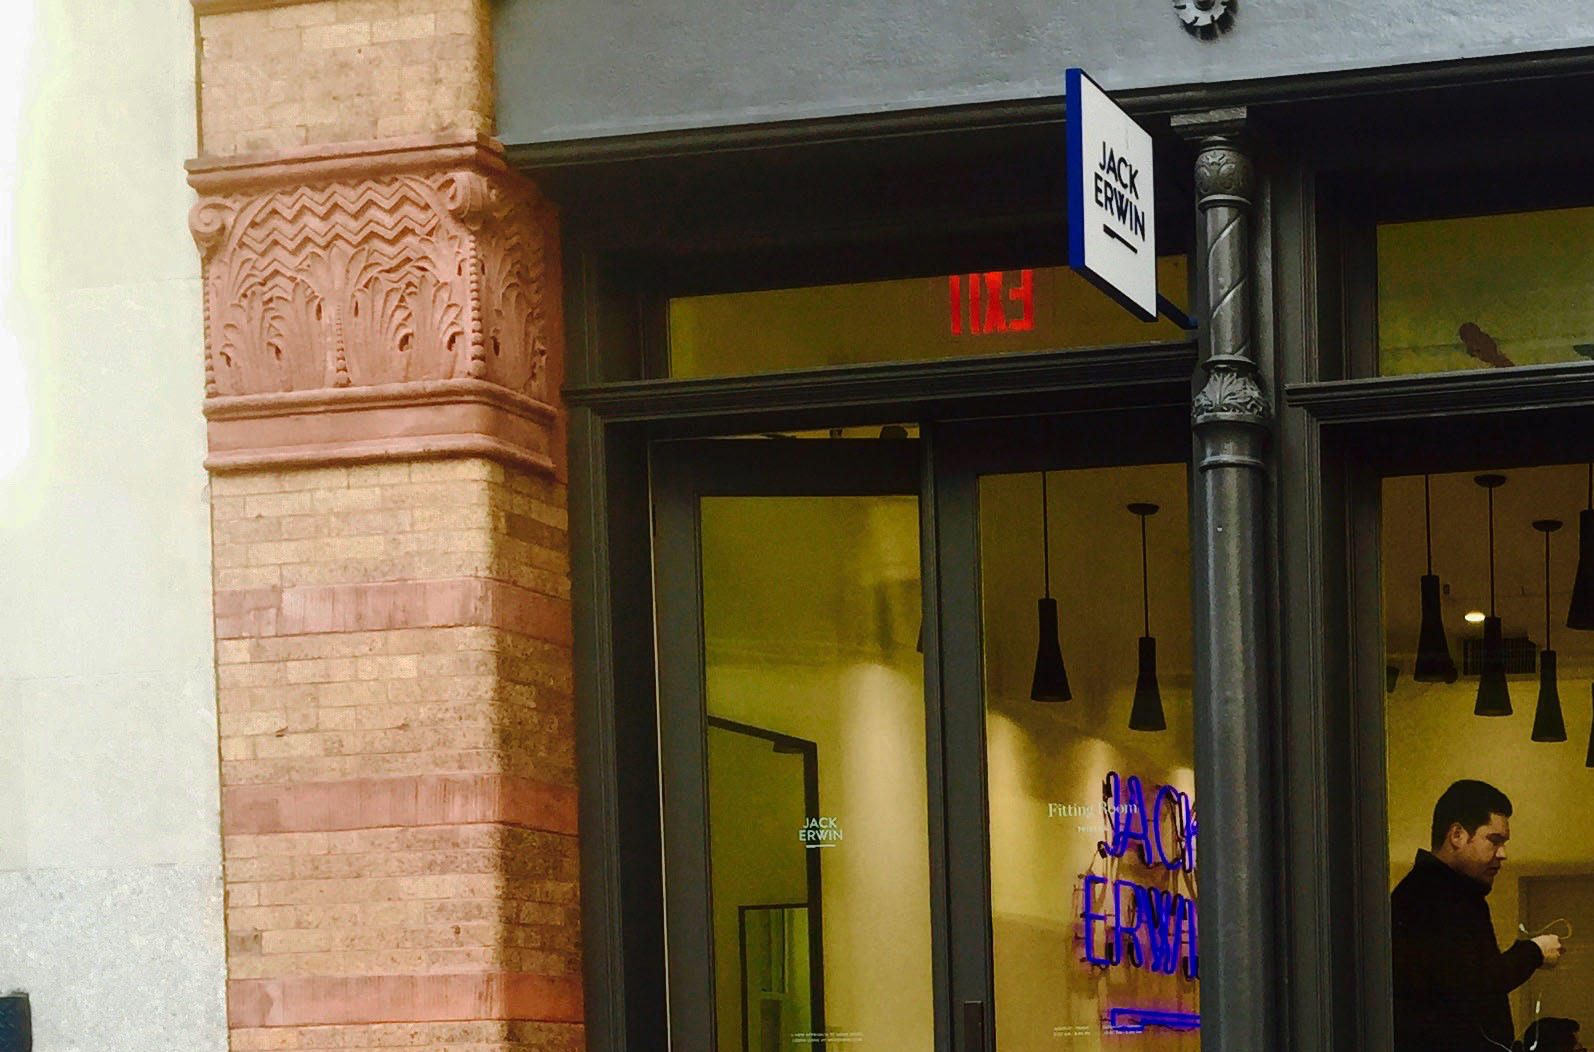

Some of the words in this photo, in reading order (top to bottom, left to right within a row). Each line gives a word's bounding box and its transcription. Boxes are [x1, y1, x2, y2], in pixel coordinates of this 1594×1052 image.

[1098, 140, 1140, 201] JACK
[1093, 171, 1146, 242] ERWIN
[1048, 802, 1095, 818] Fitting
[803, 816, 838, 829] JACK
[799, 829, 843, 842] ERWIN
